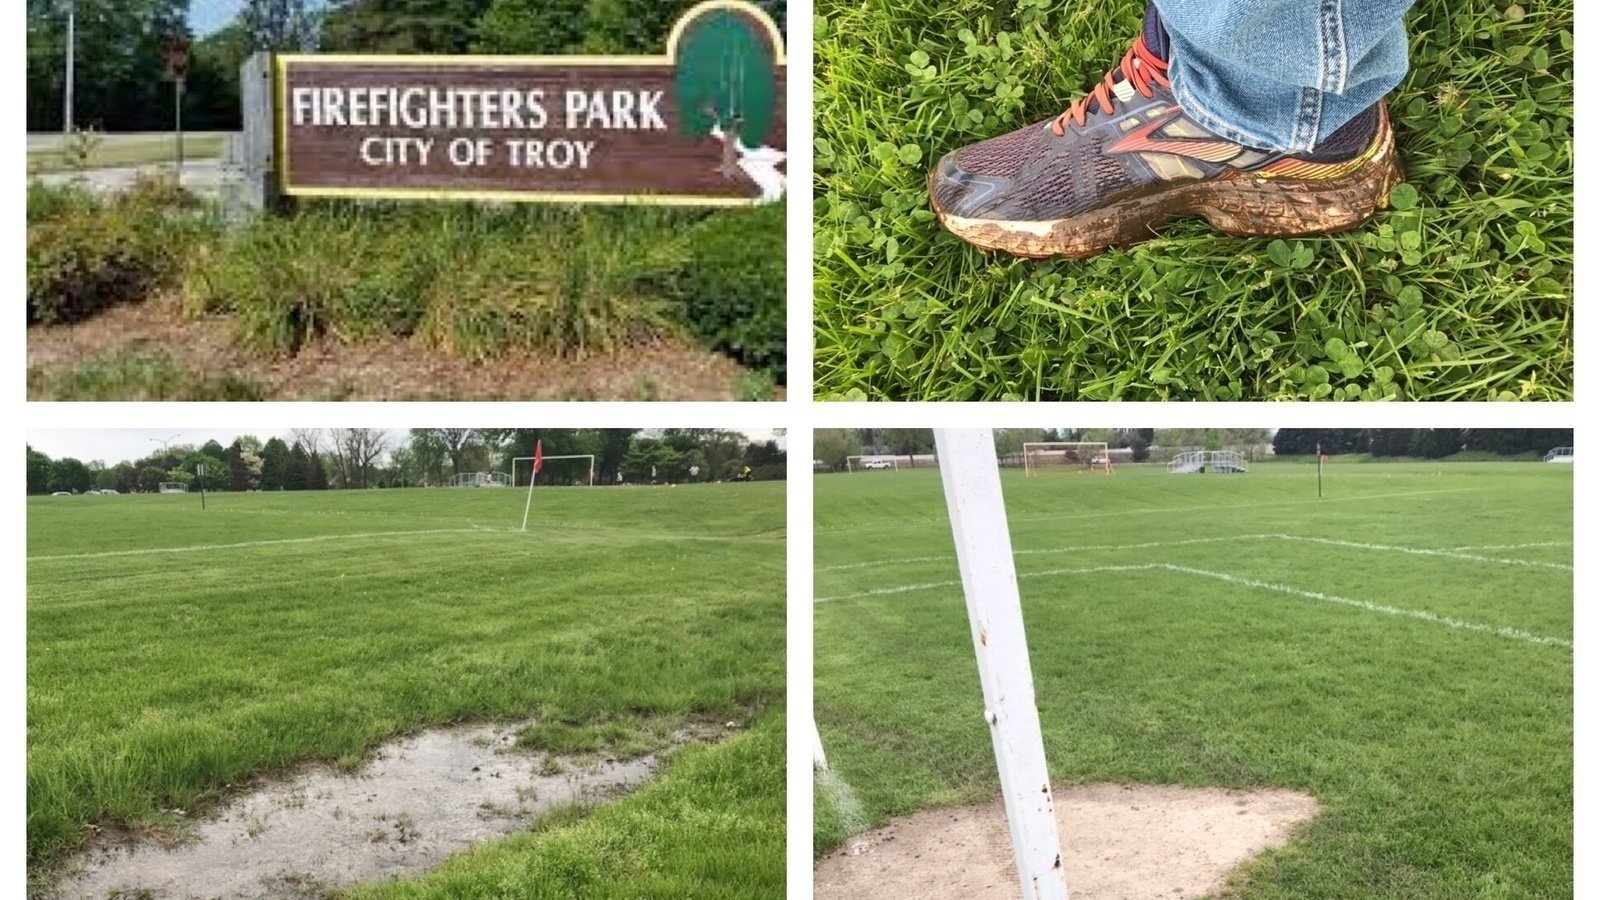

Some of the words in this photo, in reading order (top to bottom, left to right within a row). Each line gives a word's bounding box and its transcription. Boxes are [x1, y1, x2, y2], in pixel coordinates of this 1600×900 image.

[292, 87, 548, 129] FIREFIGHTERS
[565, 90, 667, 131] PARK
[360, 137, 434, 167] CITY
[449, 137, 494, 167] OF
[506, 141, 596, 169] TROY
